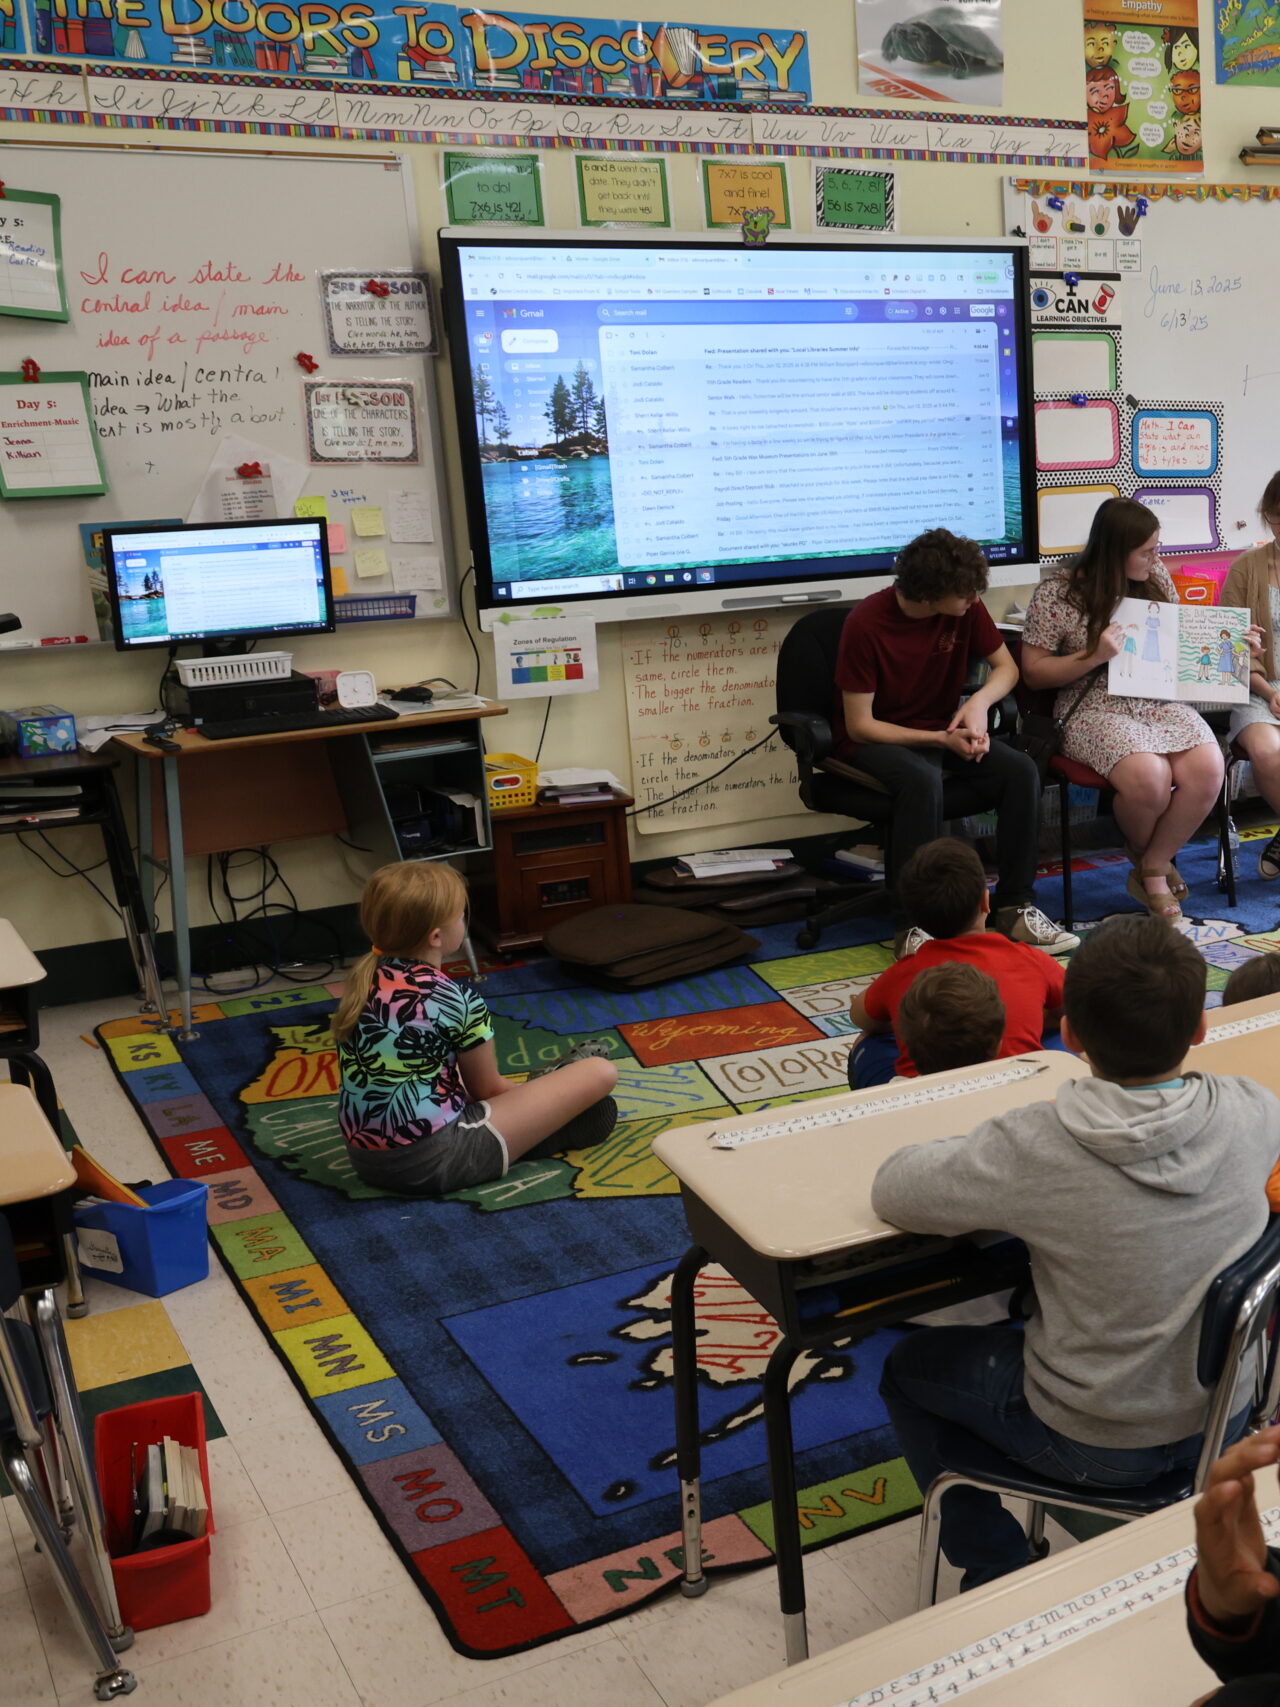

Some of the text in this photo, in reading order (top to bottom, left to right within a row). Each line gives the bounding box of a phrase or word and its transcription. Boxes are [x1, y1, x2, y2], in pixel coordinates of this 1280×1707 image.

[1121, 0, 1162, 12] Empathy
[162, 0, 803, 90] DOORS TO DISCOERY
[717, 169, 773, 180] 7x7 cool
[724, 188, 745, 198] and
[827, 201, 841, 212] 56
[80, 252, 306, 285] I can state the
[1144, 265, 1241, 318] June 2025
[160, 294, 289, 317] idea main
[520, 308, 544, 318] Gmail
[613, 309, 647, 317] Search mail
[970, 306, 994, 316] Google
[1055, 299, 1089, 313] CAN
[96, 325, 186, 361] idea of a
[87, 364, 280, 388] main idea central
[16, 399, 40, 411] Day
[94, 388, 240, 415] idea the
[1, 417, 80, 428] Enrichment-Music
[136, 411, 222, 436] is mostly
[361, 409, 408, 420] CHARACTERS
[1178, 421, 1195, 430] Can
[362, 427, 375, 437] THE
[634, 645, 767, 665] If the numerators are
[671, 663, 737, 680] circle them.
[636, 680, 715, 699] The bigger the
[638, 696, 754, 717] smaller the fraction.
[640, 749, 736, 768] If the denominators
[641, 771, 669, 785] circle
[643, 773, 784, 801] The the the
[672, 801, 718, 815] fraction.
[631, 1020, 808, 1051] Wyoming
[128, 1041, 161, 1063] KS
[720, 1042, 851, 1094] COLORA
[143, 1073, 182, 1092] KY
[162, 1104, 199, 1129] LA
[184, 1139, 227, 1167] ME
[209, 1179, 254, 1212] MD
[235, 1226, 287, 1264] MA
[269, 1279, 322, 1315] MI
[304, 1333, 364, 1379] MN
[347, 1399, 406, 1444] MS
[393, 1467, 463, 1523] MO
[797, 1477, 888, 1529] NV
[449, 1555, 524, 1614] MT
